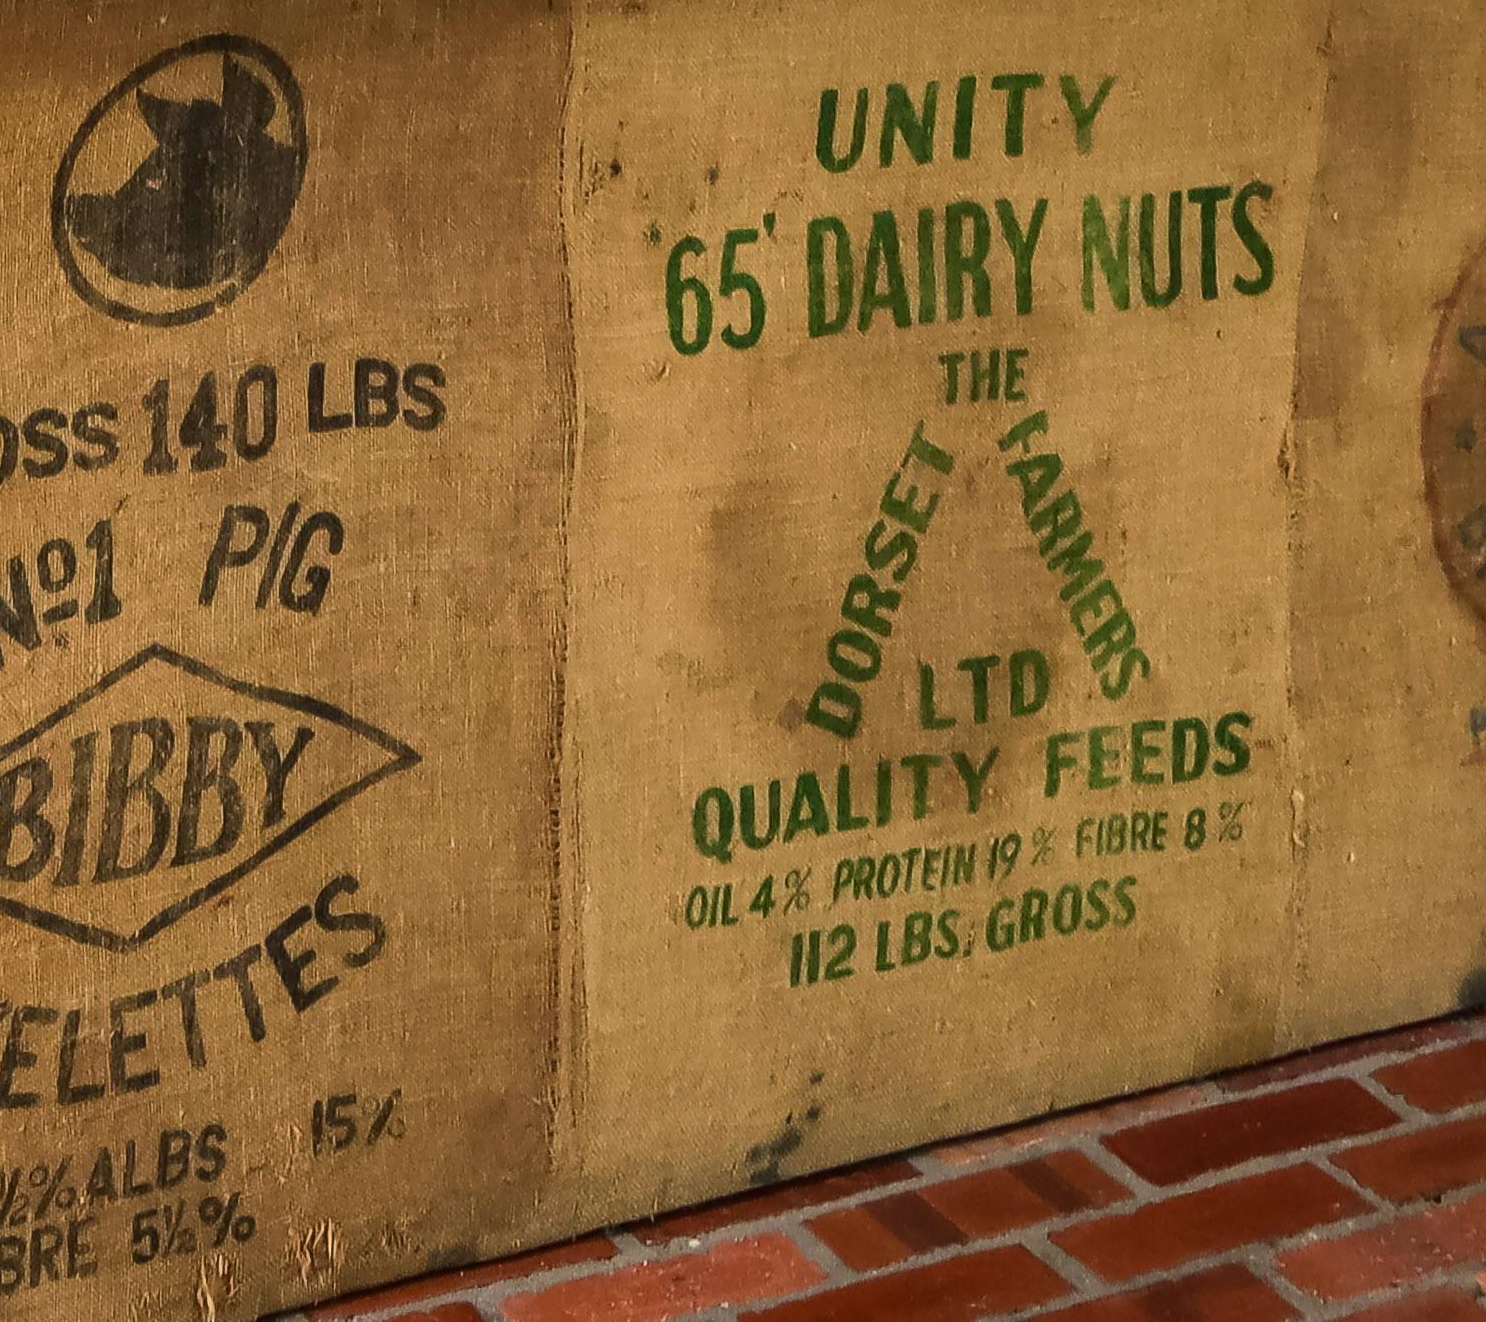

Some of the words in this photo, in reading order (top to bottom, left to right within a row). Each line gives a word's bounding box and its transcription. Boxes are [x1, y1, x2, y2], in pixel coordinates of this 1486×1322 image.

[815, 73, 1118, 174] UNITY
[806, 197, 1049, 339] DAIRY
[1081, 179, 1275, 313] NUTS
[142, 363, 278, 475] 140
[307, 357, 447, 433] LBS
[938, 348, 1029, 405] THE
[198, 499, 346, 615] PIG
[805, 419, 955, 740] DORSET
[997, 410, 1151, 701] FARMERS
[917, 649, 1050, 731] LTD
[692, 748, 1002, 865] QUALITY
[1044, 710, 1256, 798] FEEDS
[685, 883, 739, 931] OIL
[832, 844, 977, 904] PROTEIN
[1076, 811, 1169, 857] FIBRE
[790, 923, 858, 988] 112
[986, 876, 1137, 952] GROSS
[86, 1122, 228, 1207] ALBS
[311, 1088, 405, 1158] 15%
